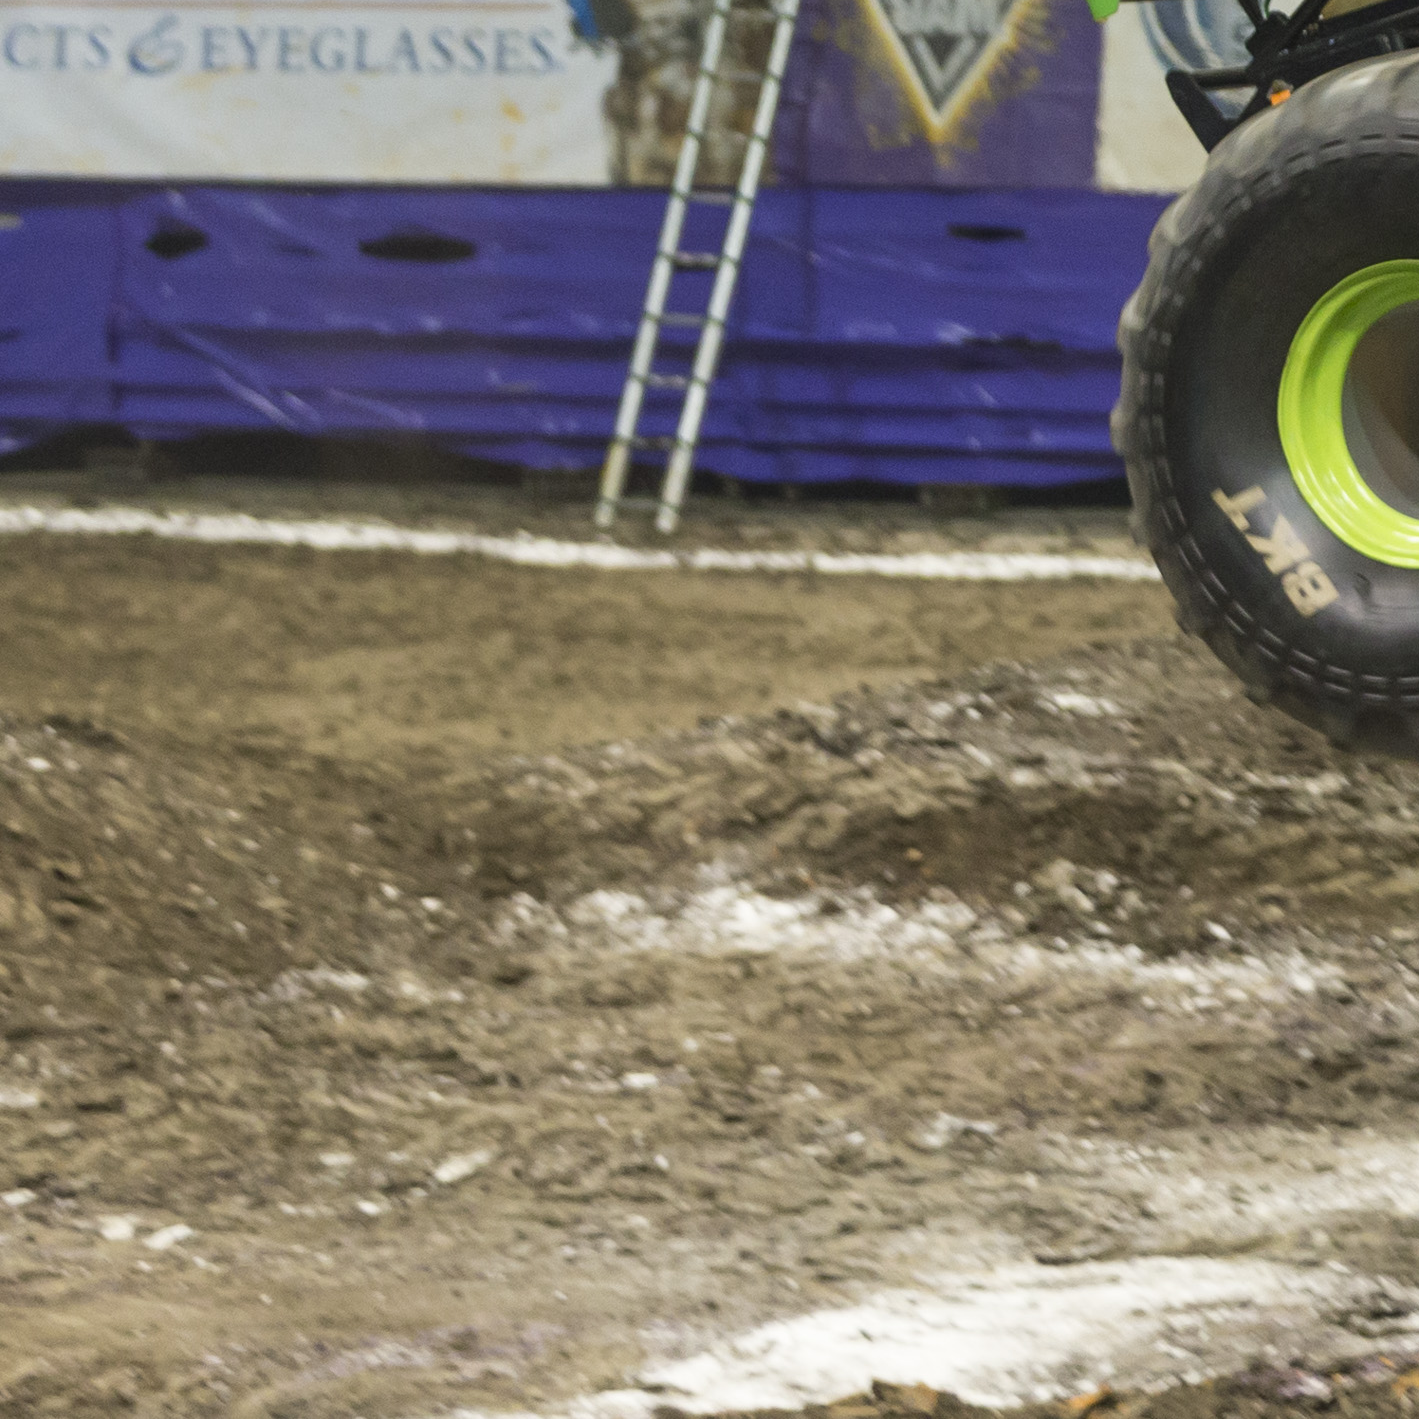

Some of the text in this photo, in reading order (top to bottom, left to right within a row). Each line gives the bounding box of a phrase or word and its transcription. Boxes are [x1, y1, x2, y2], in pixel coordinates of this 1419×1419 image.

[127, 12, 187, 76] &
[201, 23, 560, 75] EYEGLASSES
[1212, 486, 1340, 617] BKT
